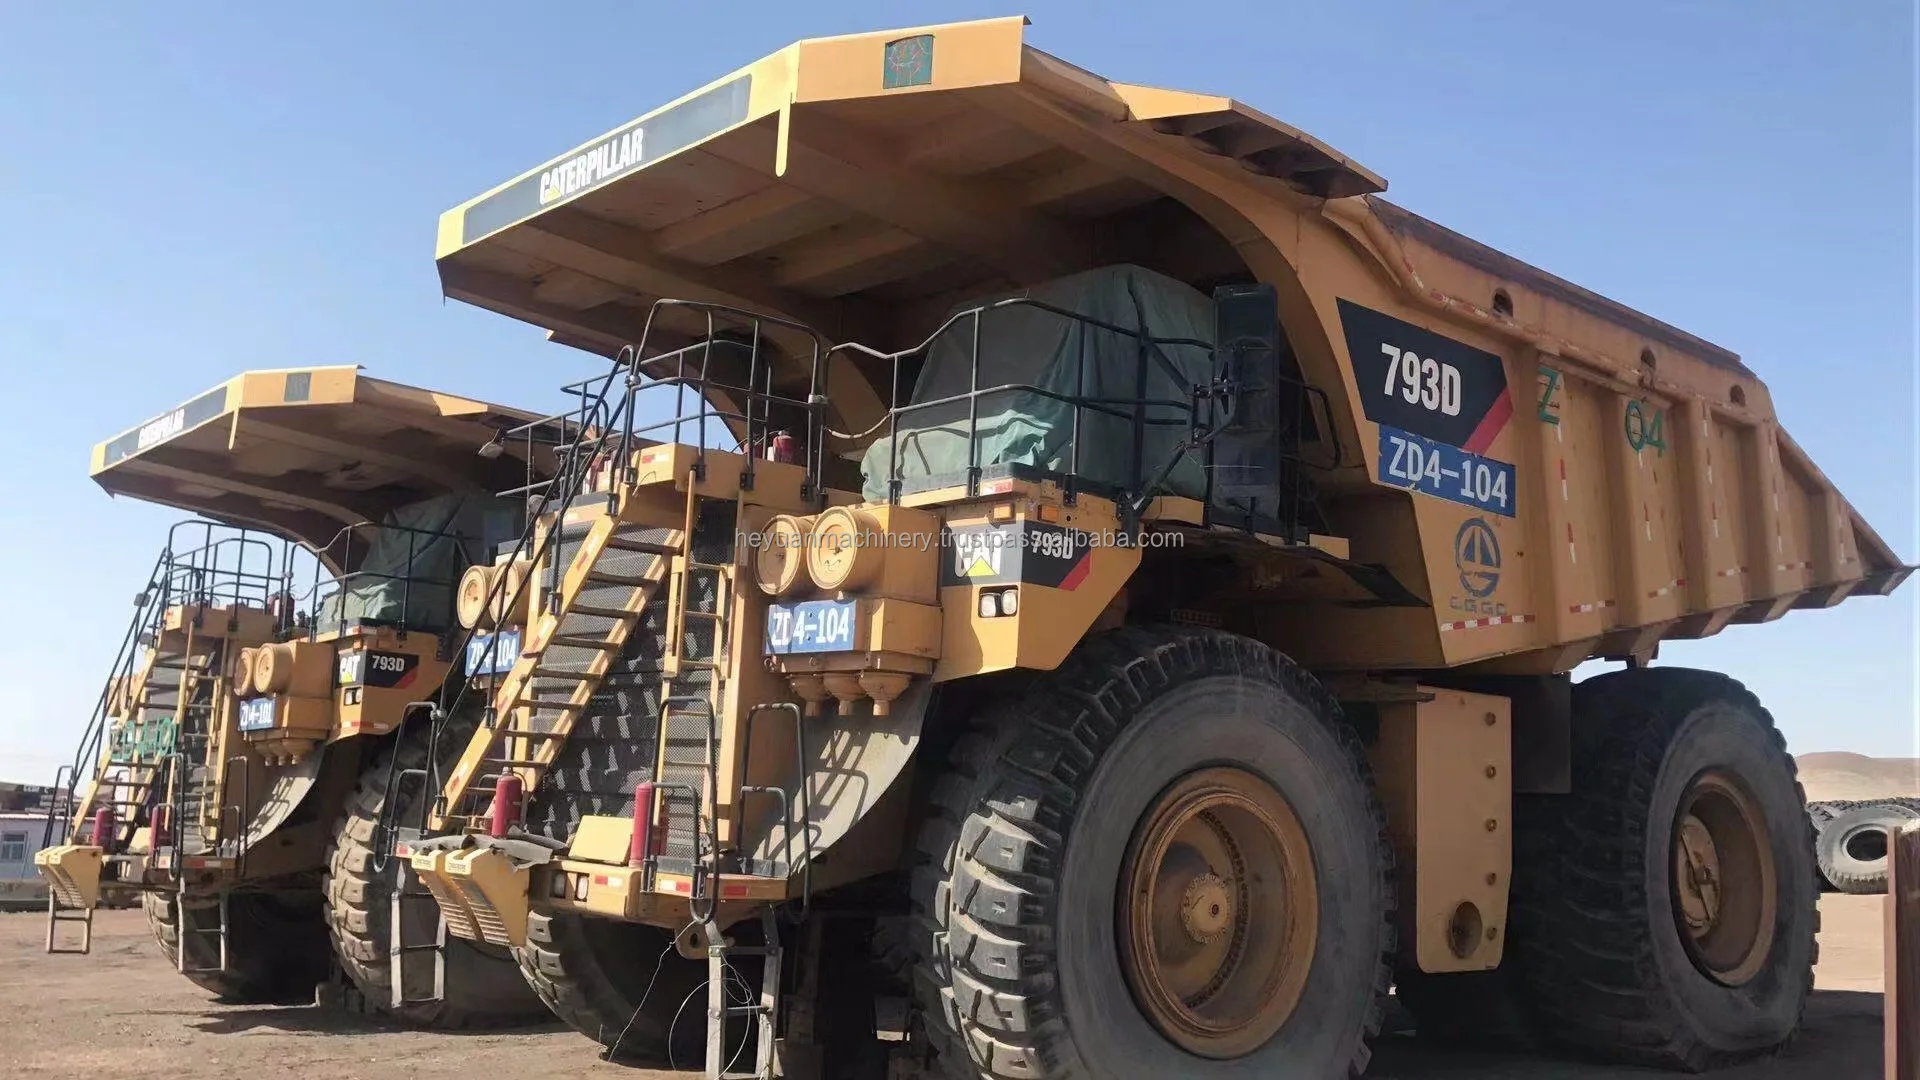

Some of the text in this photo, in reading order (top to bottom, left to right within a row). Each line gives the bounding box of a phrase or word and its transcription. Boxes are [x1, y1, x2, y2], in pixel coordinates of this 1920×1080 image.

[540, 127, 644, 205] CATERPILLAR
[1381, 342, 1462, 417] 793D
[1389, 435, 1508, 508] ZD4-104
[954, 530, 1007, 578] CAT
[1031, 530, 1074, 560] 793D
[339, 655, 361, 684] CAT
[372, 655, 405, 672] 793D
